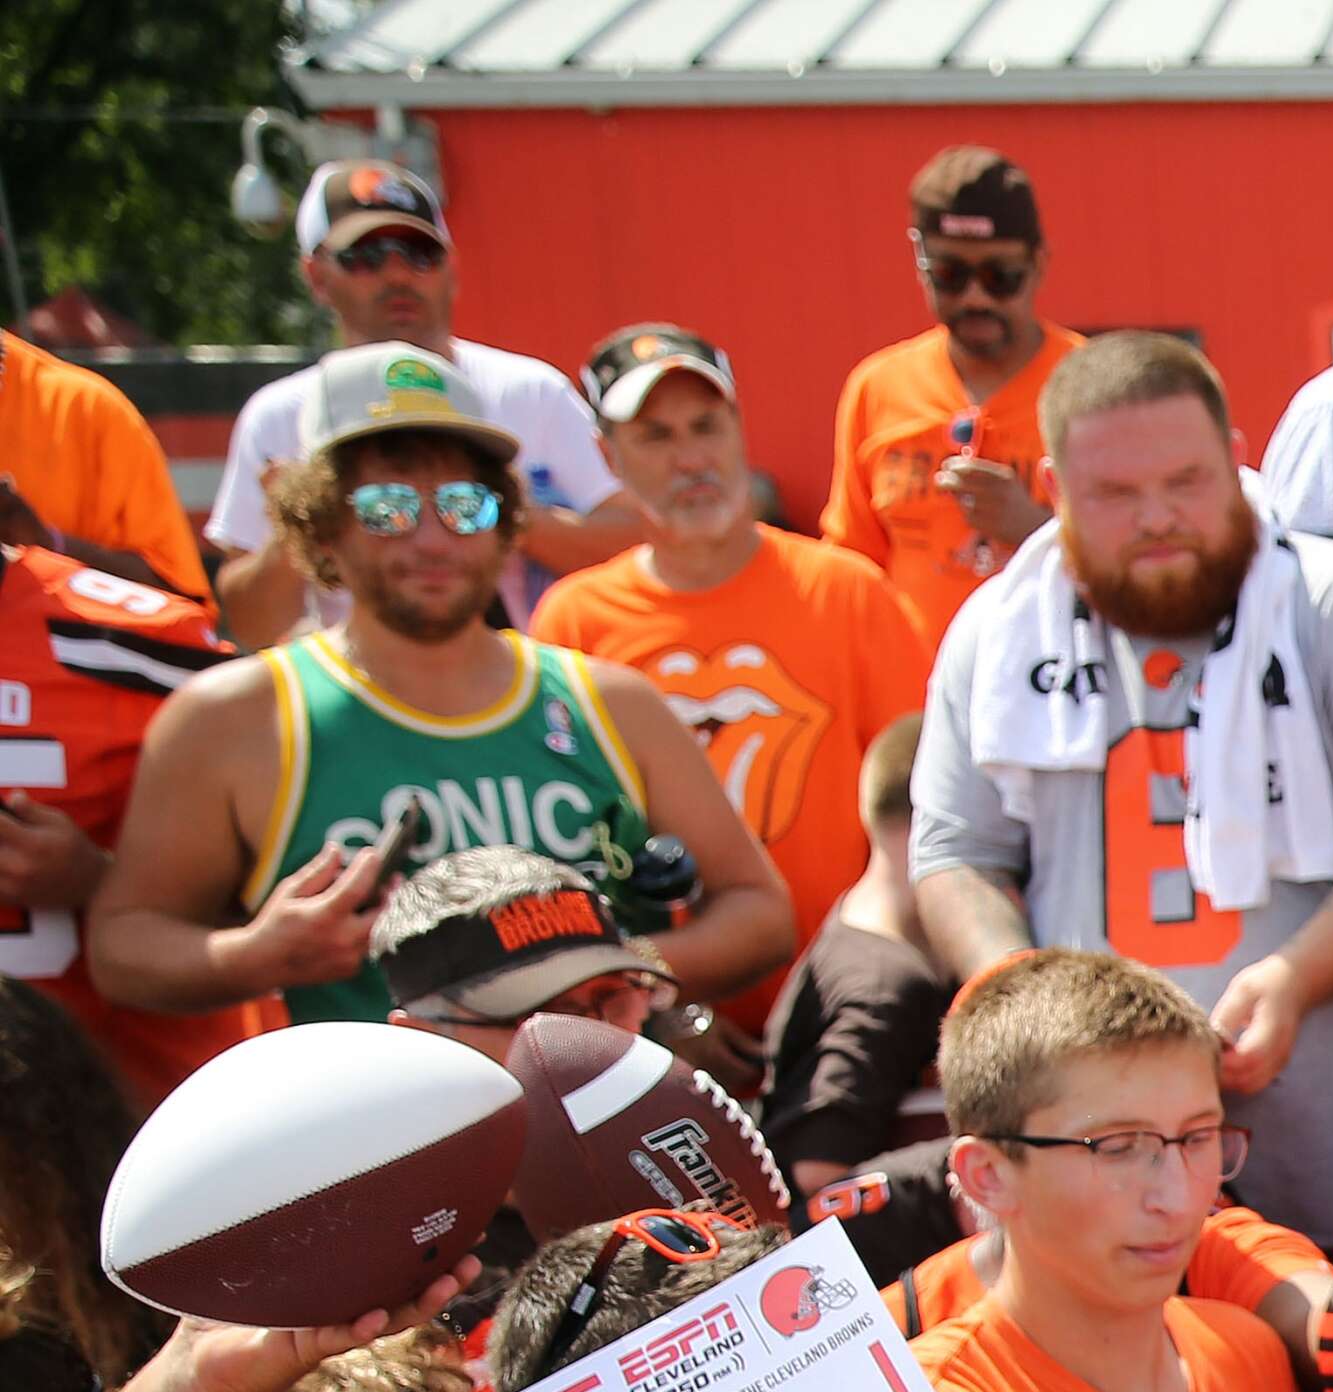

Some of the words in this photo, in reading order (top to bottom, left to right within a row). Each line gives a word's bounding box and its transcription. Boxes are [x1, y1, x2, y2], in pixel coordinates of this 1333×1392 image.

[618, 1302, 738, 1387] ESPN
[765, 1341, 829, 1390] CLEVELAND
[827, 1312, 875, 1352] BROWNS
